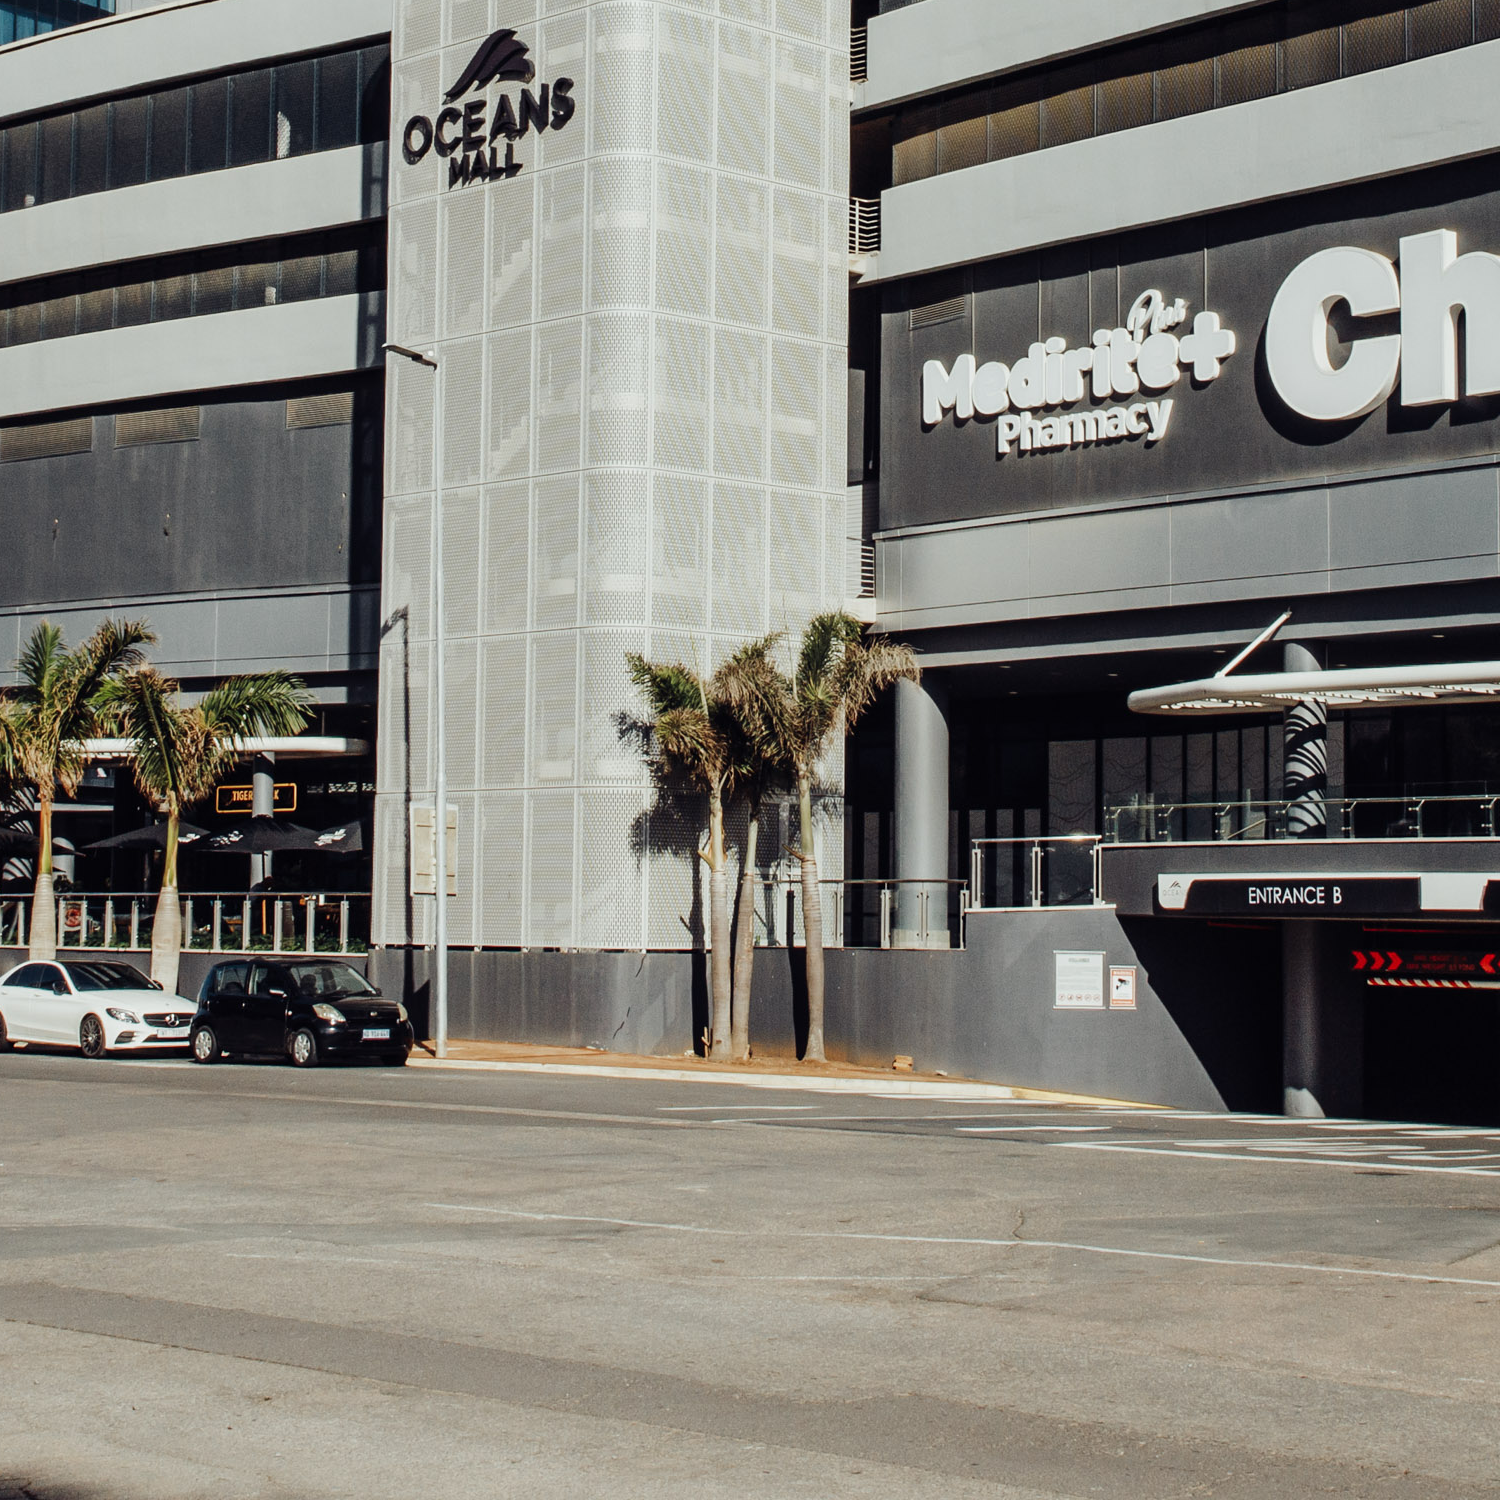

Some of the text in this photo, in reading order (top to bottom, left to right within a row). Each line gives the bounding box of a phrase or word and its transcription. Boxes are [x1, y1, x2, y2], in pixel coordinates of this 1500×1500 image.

[402, 77, 575, 165] OCEANS
[448, 143, 524, 190] MALL
[997, 399, 1174, 453] Pharmacy
[1248, 886, 1343, 905] ENTRANCE B
